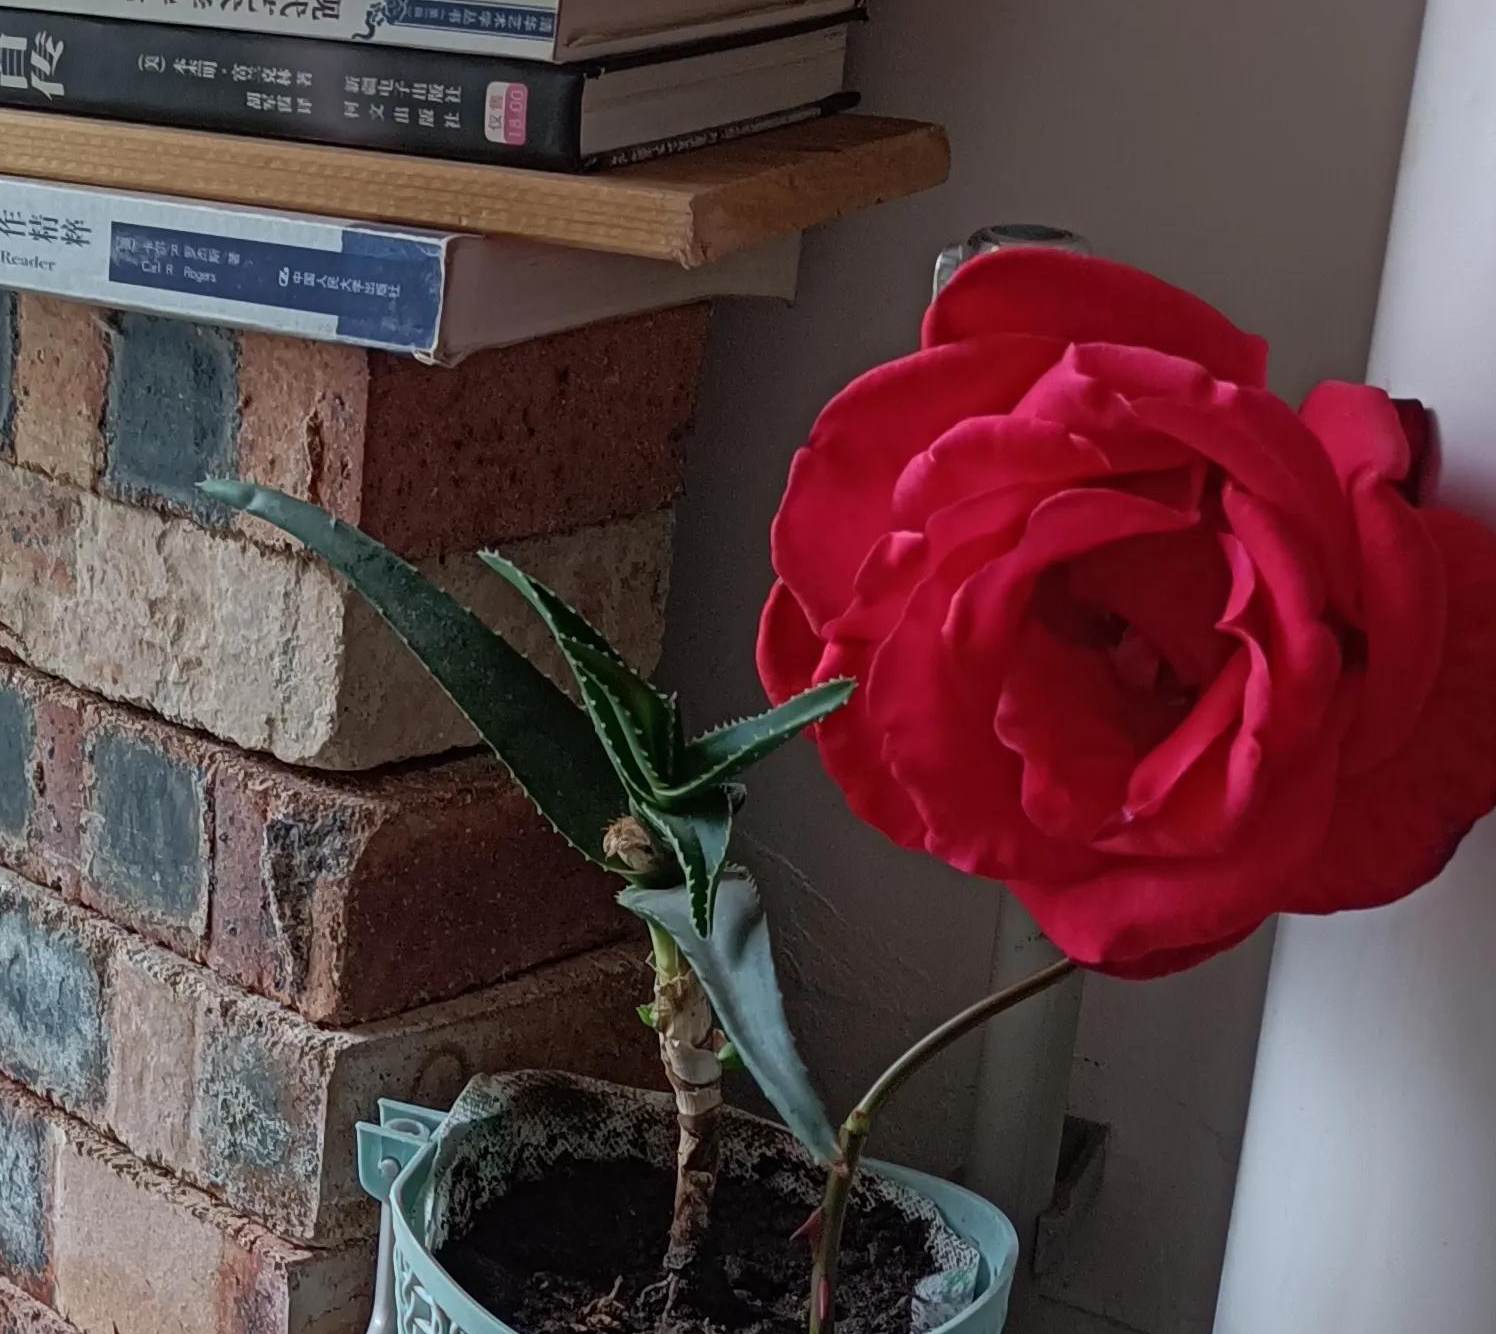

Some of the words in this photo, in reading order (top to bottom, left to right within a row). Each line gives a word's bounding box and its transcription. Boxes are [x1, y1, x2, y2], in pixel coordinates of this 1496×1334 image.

[137, 53, 166, 74] （美）
[172, 57, 293, 88] 本杰明·富兰克林
[296, 70, 313, 87] 著
[343, 74, 463, 104] 新疆电子出版社
[296, 98, 313, 116] 译
[488, 95, 504, 132] 仅售
[507, 88, 526, 140] 18.00
[0, 249, 57, 272] Reader
[292, 270, 402, 299] 中国人民大学出版社
